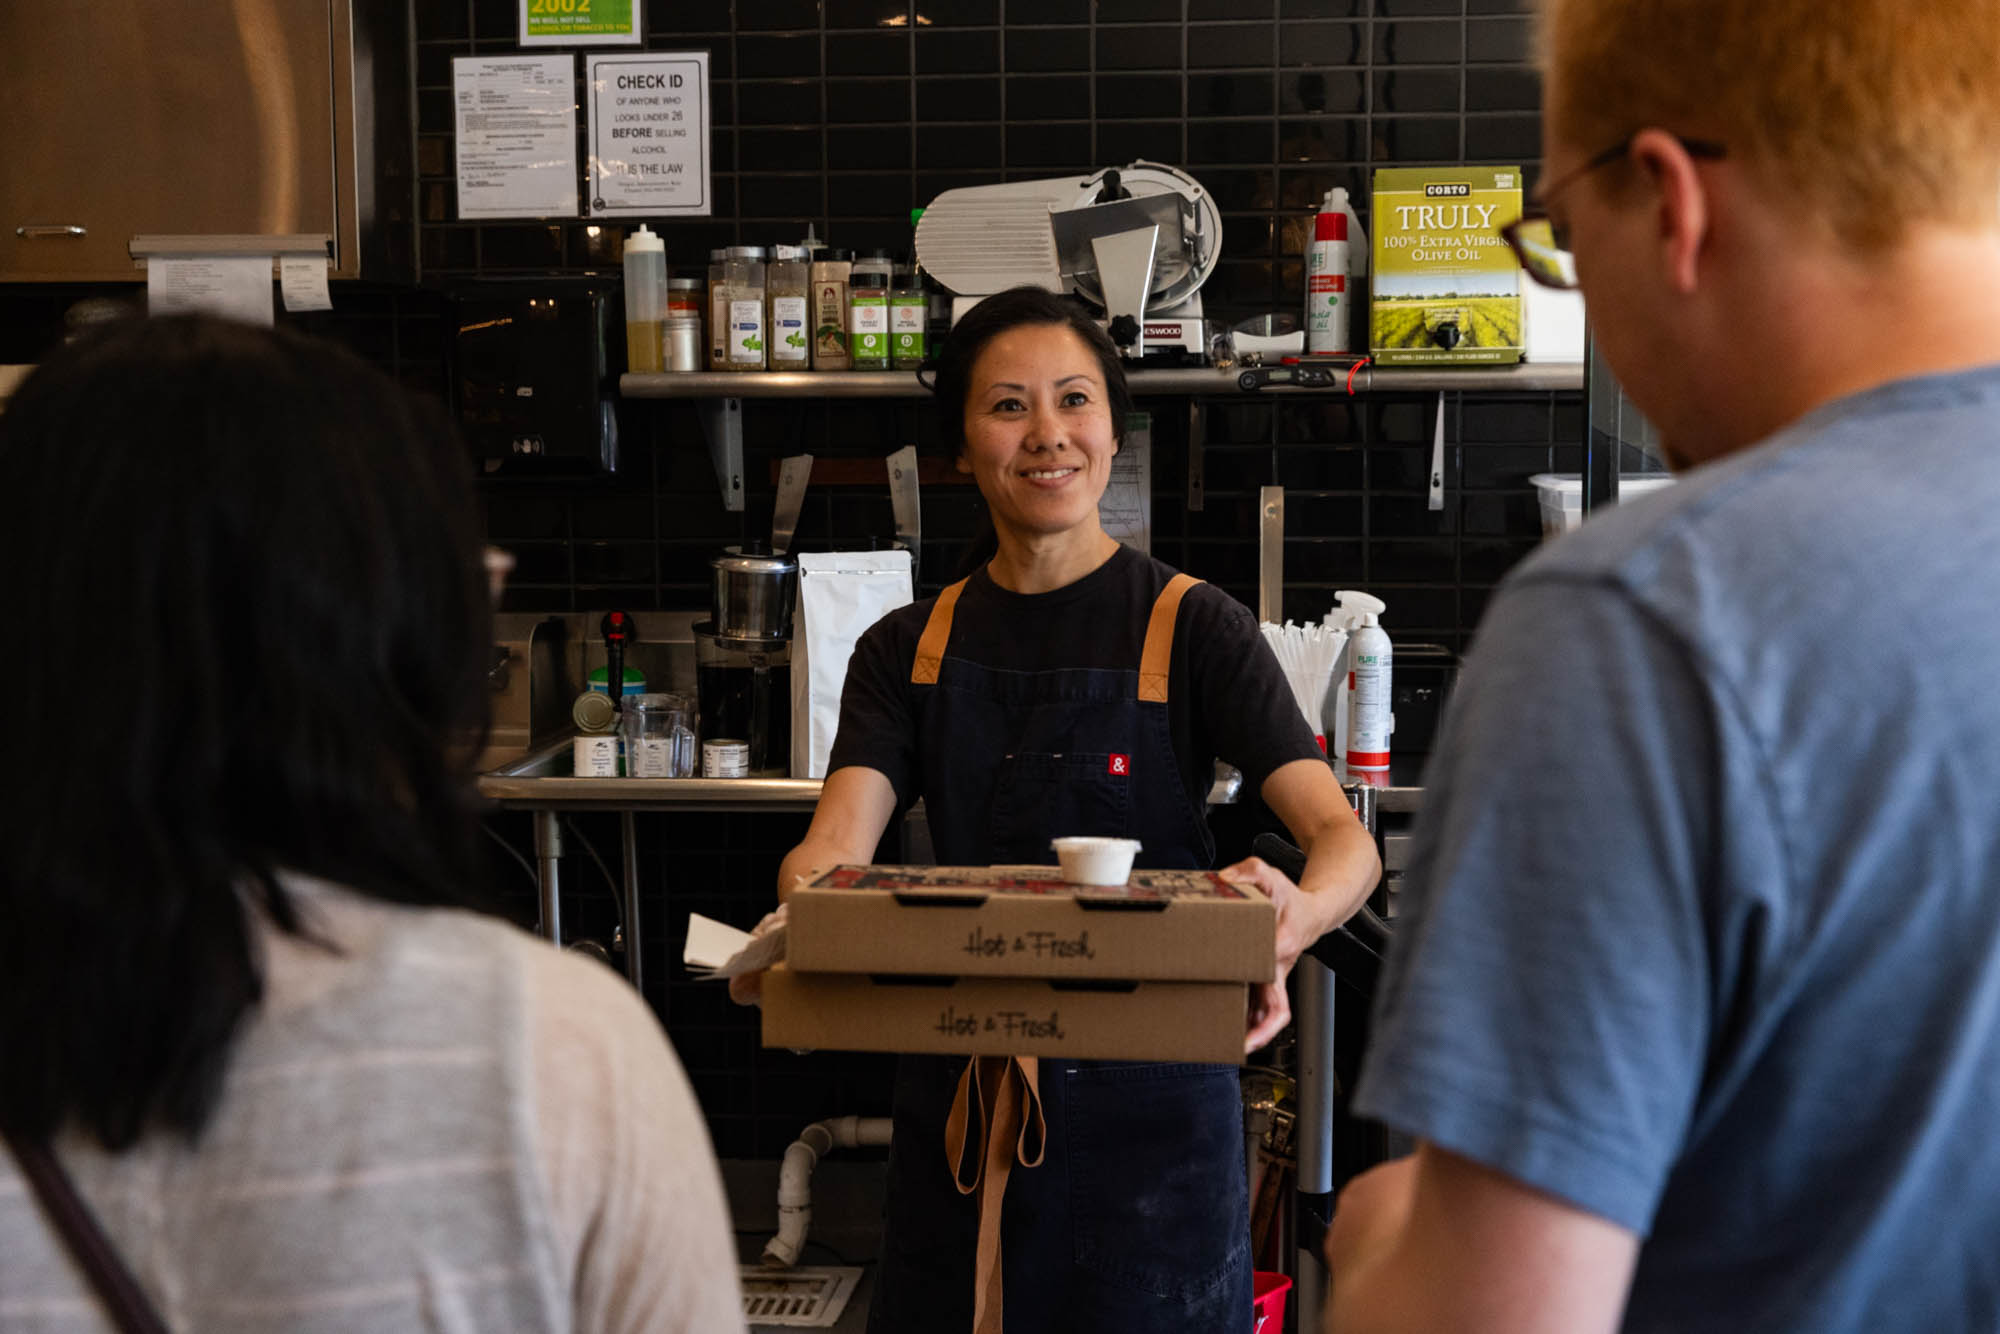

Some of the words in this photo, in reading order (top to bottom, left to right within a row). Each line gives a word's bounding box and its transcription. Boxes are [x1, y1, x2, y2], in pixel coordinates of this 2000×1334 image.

[560, 16, 574, 24] NOT
[617, 75, 665, 89] CHECK
[669, 74, 683, 88] ID
[616, 98, 626, 106] OF
[629, 97, 659, 105] ANYONE
[663, 96, 681, 104] WHO
[615, 113, 641, 122] LOOKS
[643, 113, 669, 121] UNDER
[612, 128, 652, 138] BEFORE
[655, 129, 686, 137] SELLING
[632, 146, 667, 154] ALCOHOL
[628, 164, 637, 175] IS
[640, 164, 659, 174] THE
[662, 164, 683, 174] LAW
[1427, 185, 1467, 195] CORTO
[1395, 204, 1497, 230] TRULY
[1384, 236, 1416, 248] 100%
[1456, 248, 1482, 260] OIL
[867, 336, 874, 345] P
[903, 336, 911, 345] D
[1358, 656, 1378, 664] PURE
[963, 926, 1006, 958] Hot
[935, 1006, 977, 1037] Hot
